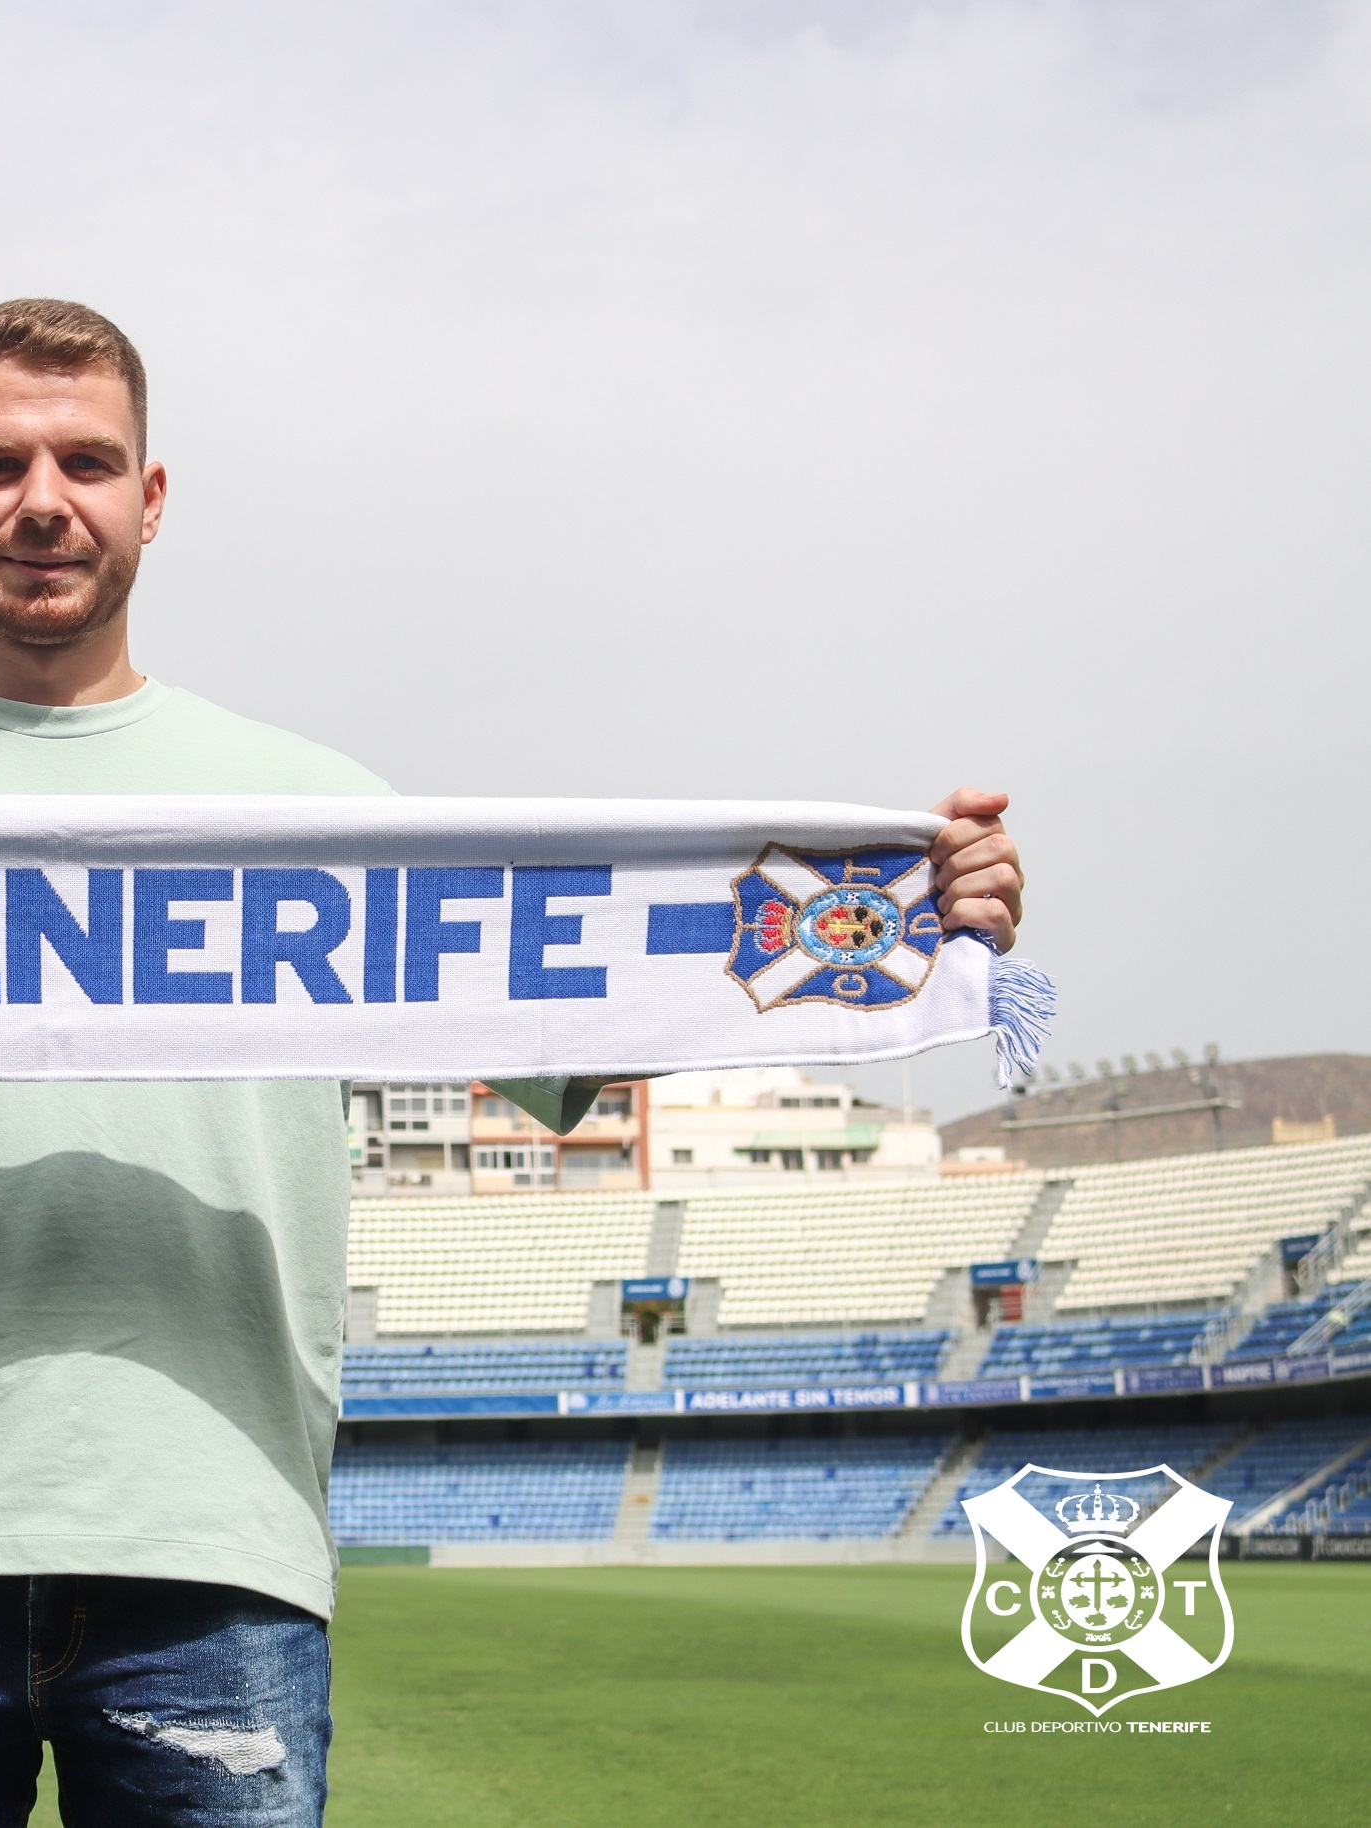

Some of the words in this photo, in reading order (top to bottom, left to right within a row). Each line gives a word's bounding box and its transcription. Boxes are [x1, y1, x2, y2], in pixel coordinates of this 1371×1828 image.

[689, 1390, 791, 1410] ADELANTE
[793, 1388, 830, 1407] SIN
[831, 1385, 899, 1406] TEMOR
